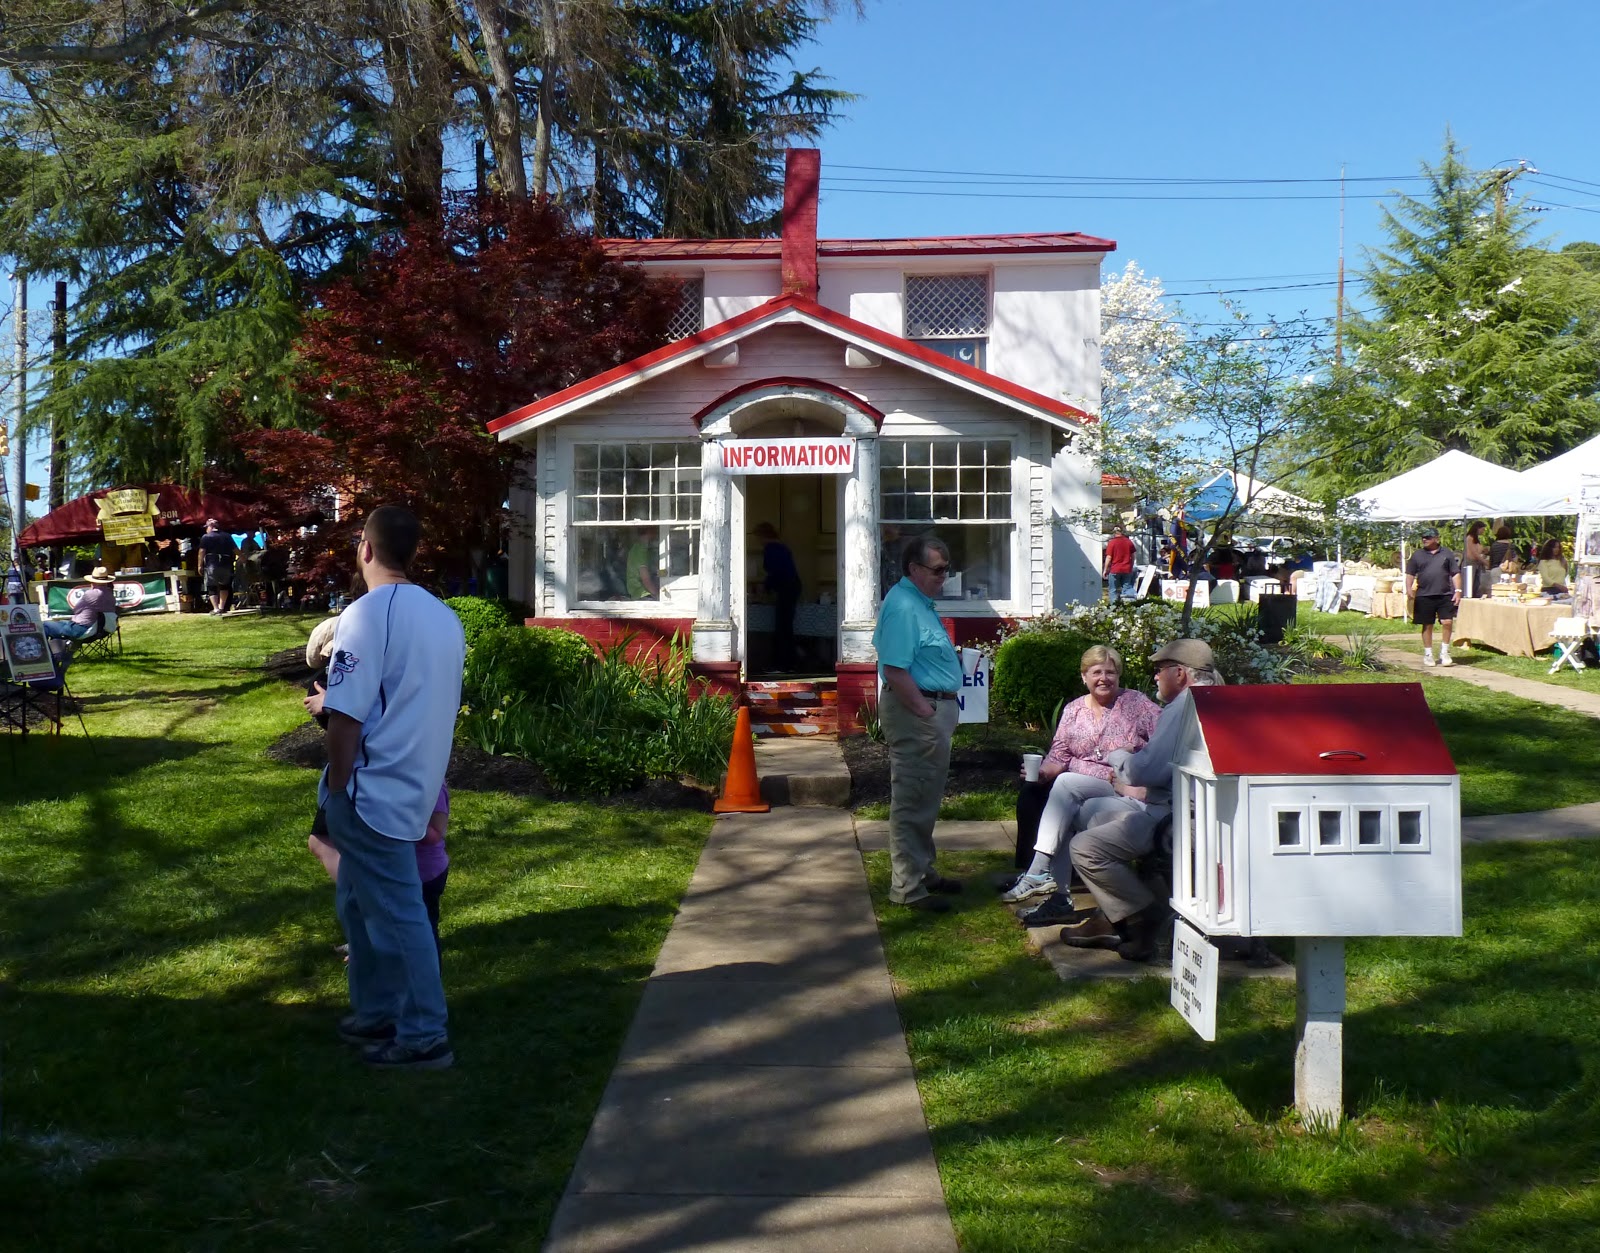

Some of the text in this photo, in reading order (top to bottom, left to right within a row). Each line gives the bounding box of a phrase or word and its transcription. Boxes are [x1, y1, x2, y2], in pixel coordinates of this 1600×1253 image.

[723, 444, 851, 468] INFORMATION
[1177, 938, 1203, 969] LITTLE FREE
[1182, 966, 1198, 988] LIBRARY
[1180, 982, 1191, 1001] Scout
[1191, 991, 1202, 1014] Troop
